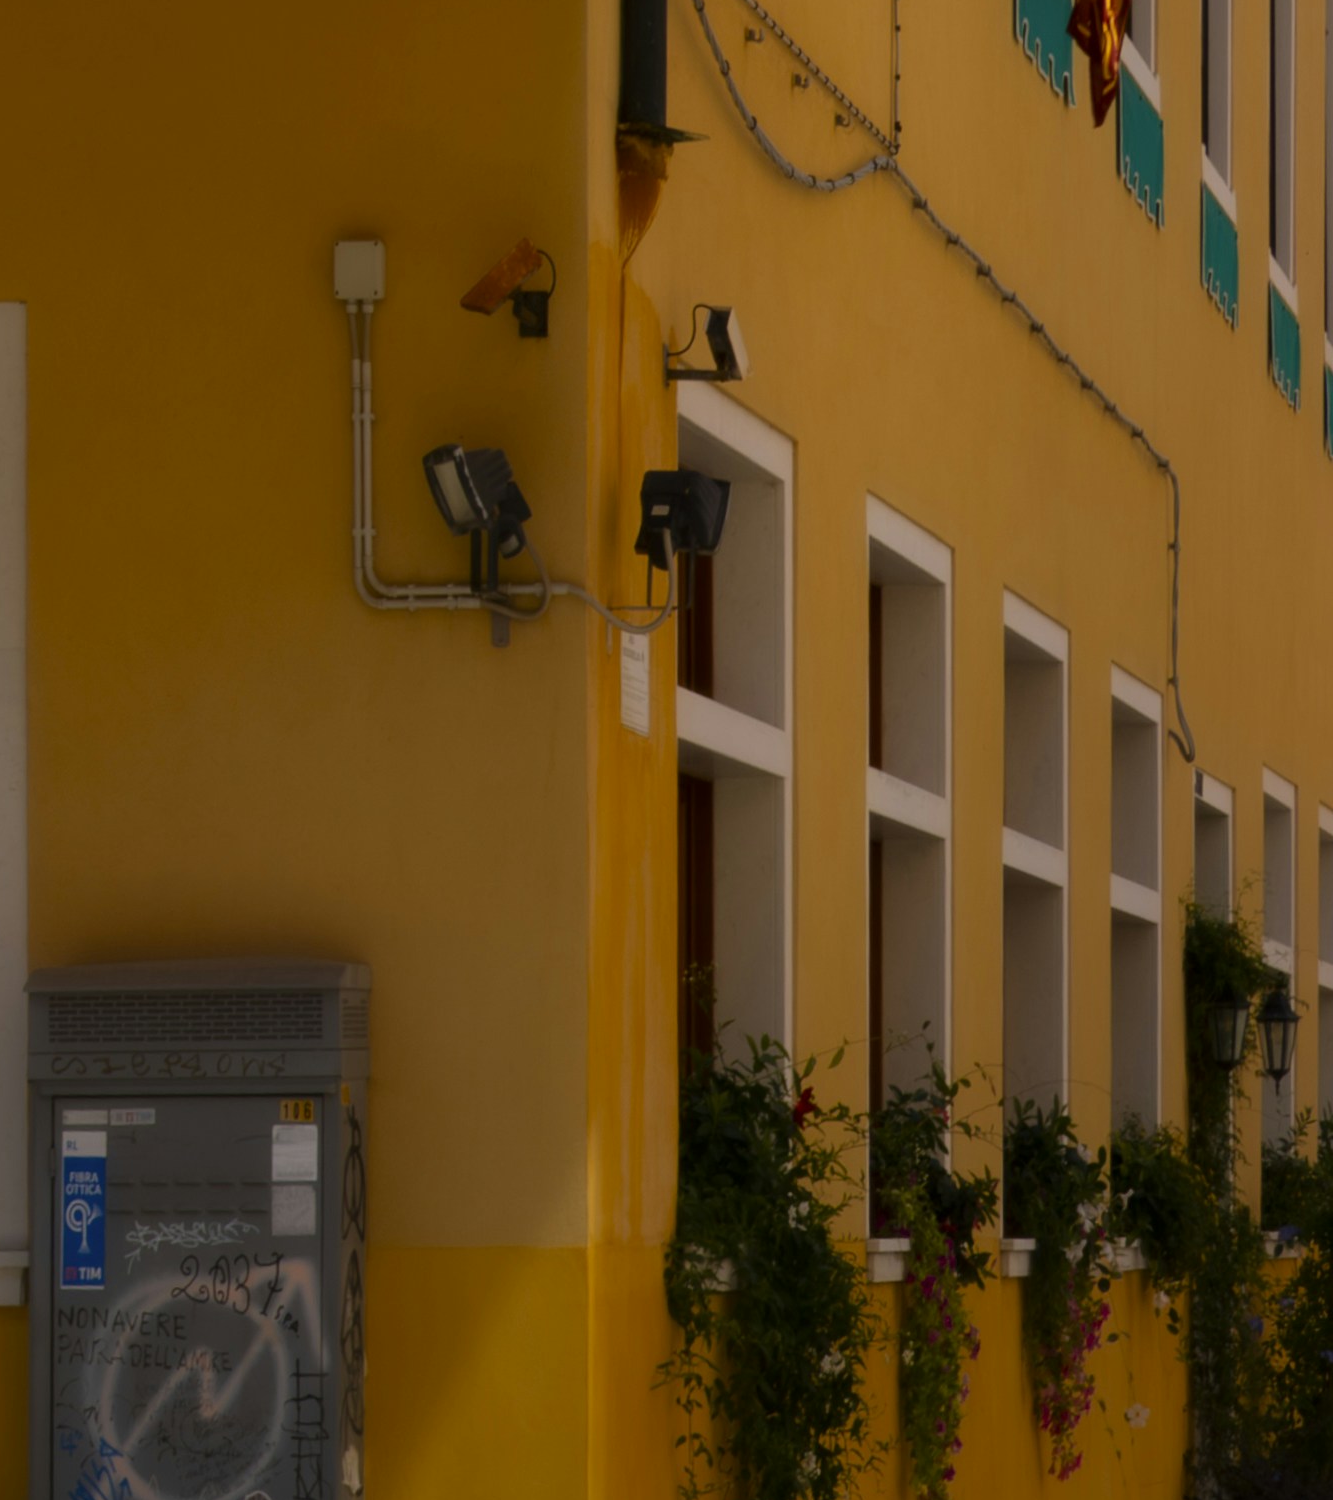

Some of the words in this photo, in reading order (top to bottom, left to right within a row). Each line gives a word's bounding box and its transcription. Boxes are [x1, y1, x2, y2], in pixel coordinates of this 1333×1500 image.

[282, 1100, 312, 1120] 106
[68, 1171, 99, 1183] FIBRA
[65, 1183, 102, 1196] OTTICA
[78, 1267, 102, 1280] TIM
[57, 1305, 109, 1330] NON
[111, 1310, 187, 1340] AVERE
